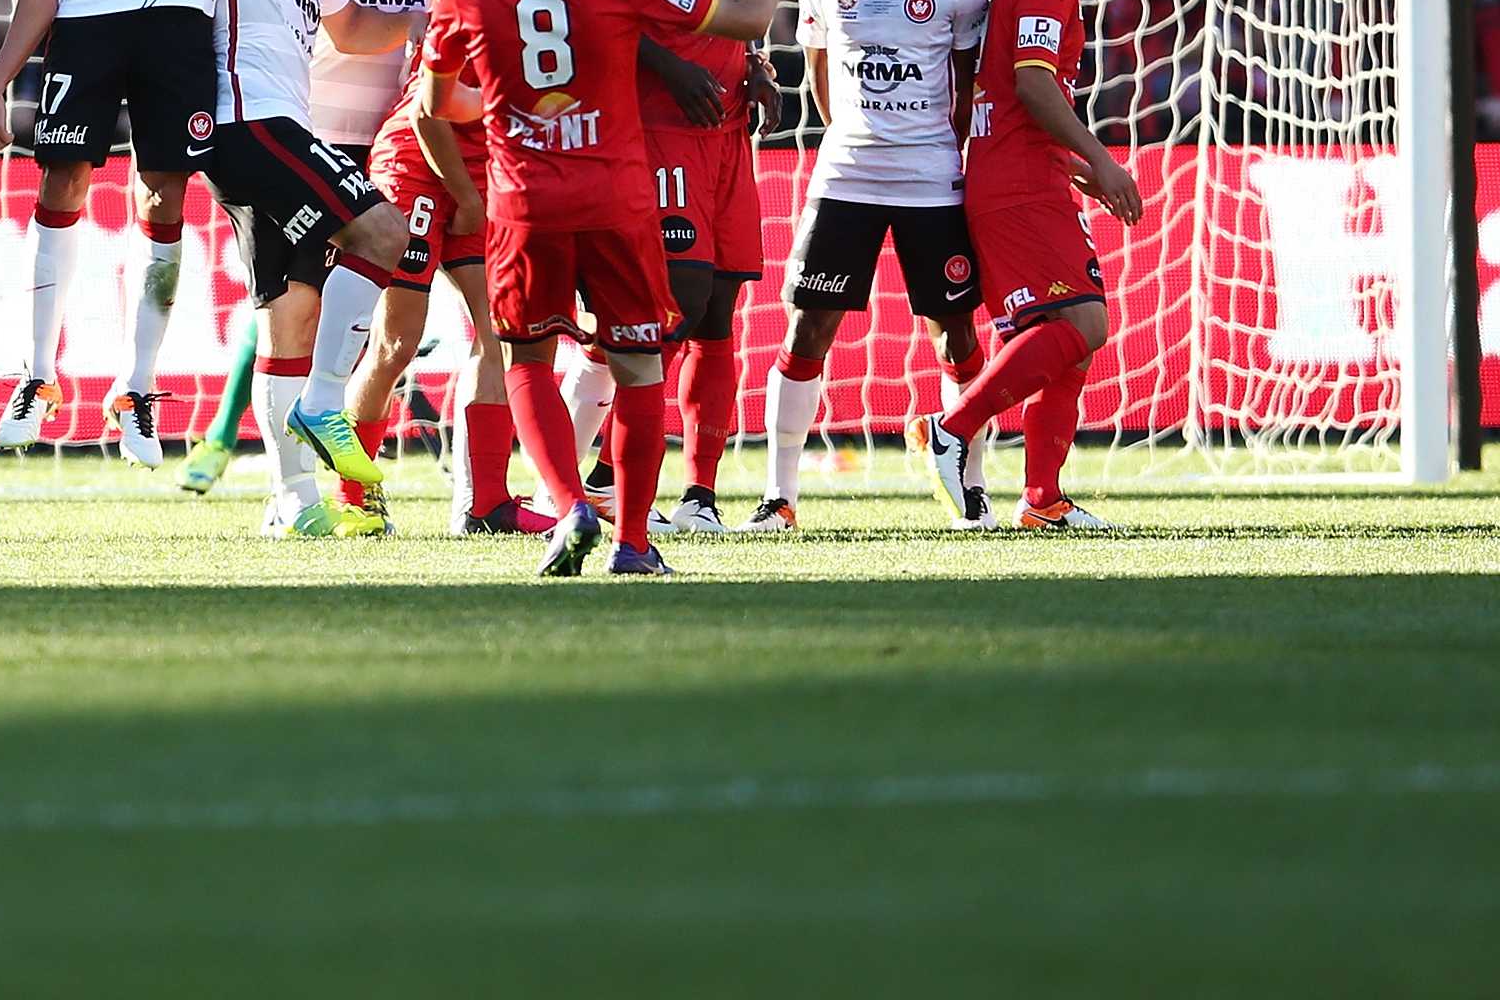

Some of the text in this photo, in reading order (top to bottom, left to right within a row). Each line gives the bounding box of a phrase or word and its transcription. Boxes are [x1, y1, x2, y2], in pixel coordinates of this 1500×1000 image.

[841, 60, 923, 81] NRMA
[41, 72, 72, 115] 17
[861, 99, 929, 112] URANCE
[656, 166, 686, 208] 11
[409, 195, 435, 237] 6
